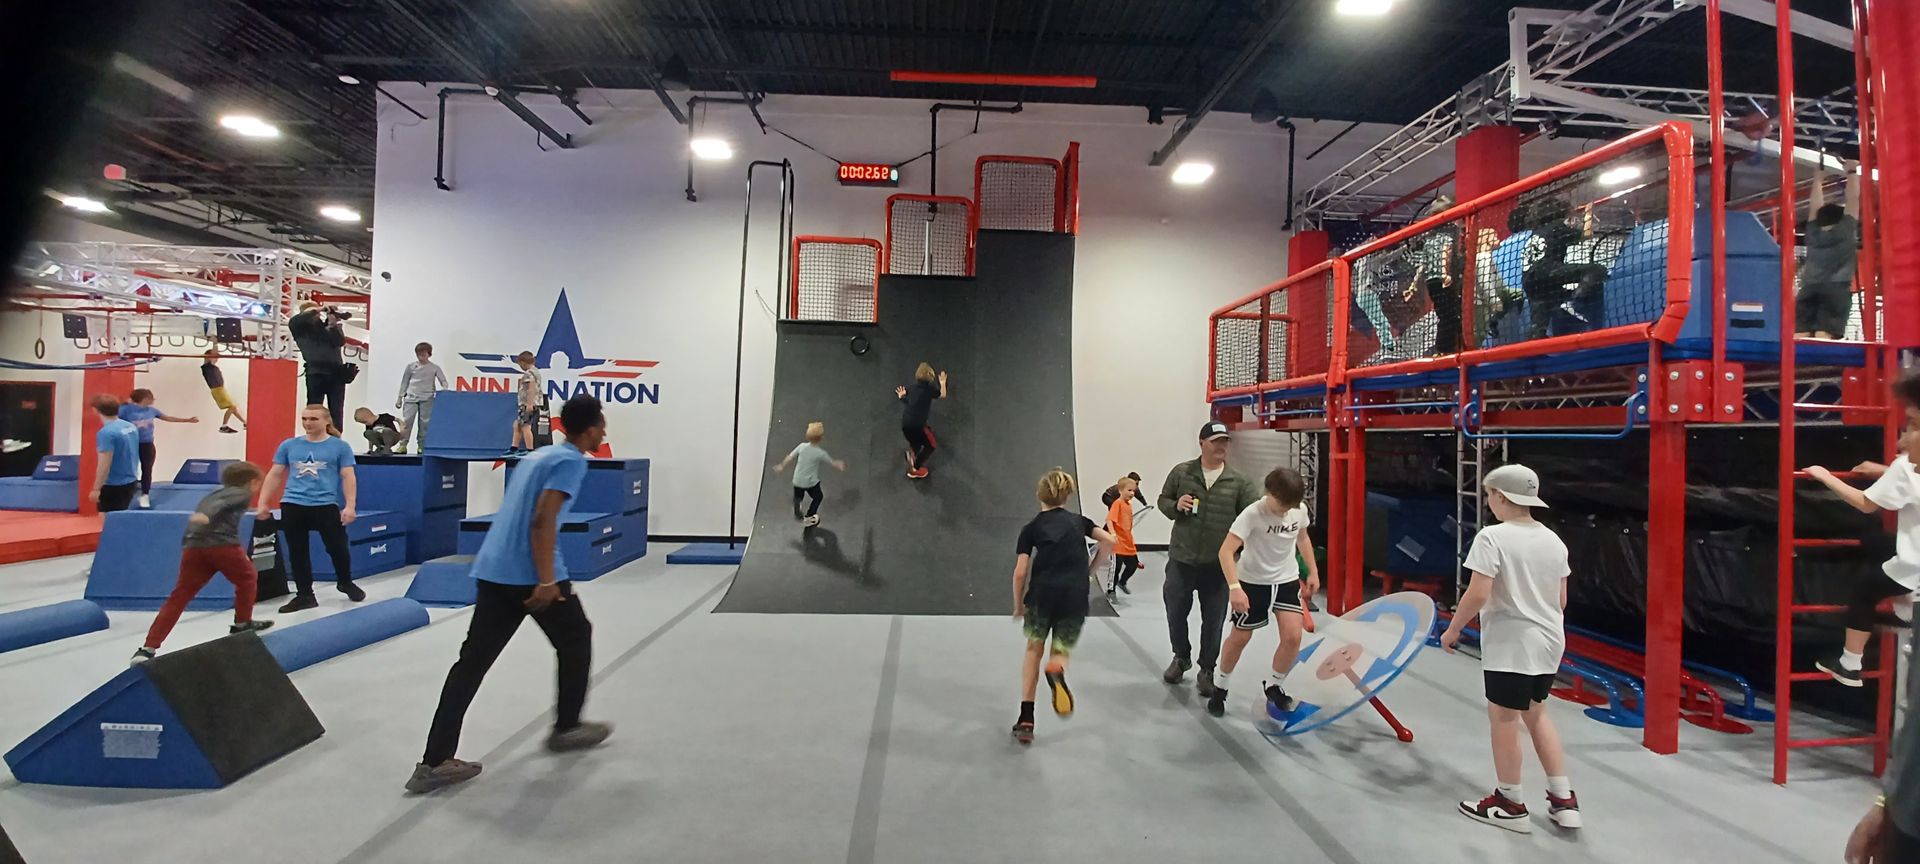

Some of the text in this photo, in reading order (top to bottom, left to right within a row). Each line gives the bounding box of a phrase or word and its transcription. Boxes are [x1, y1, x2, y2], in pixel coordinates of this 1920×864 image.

[456, 376, 660, 404] NIN NATION
[1266, 521, 1299, 534] NIKE
